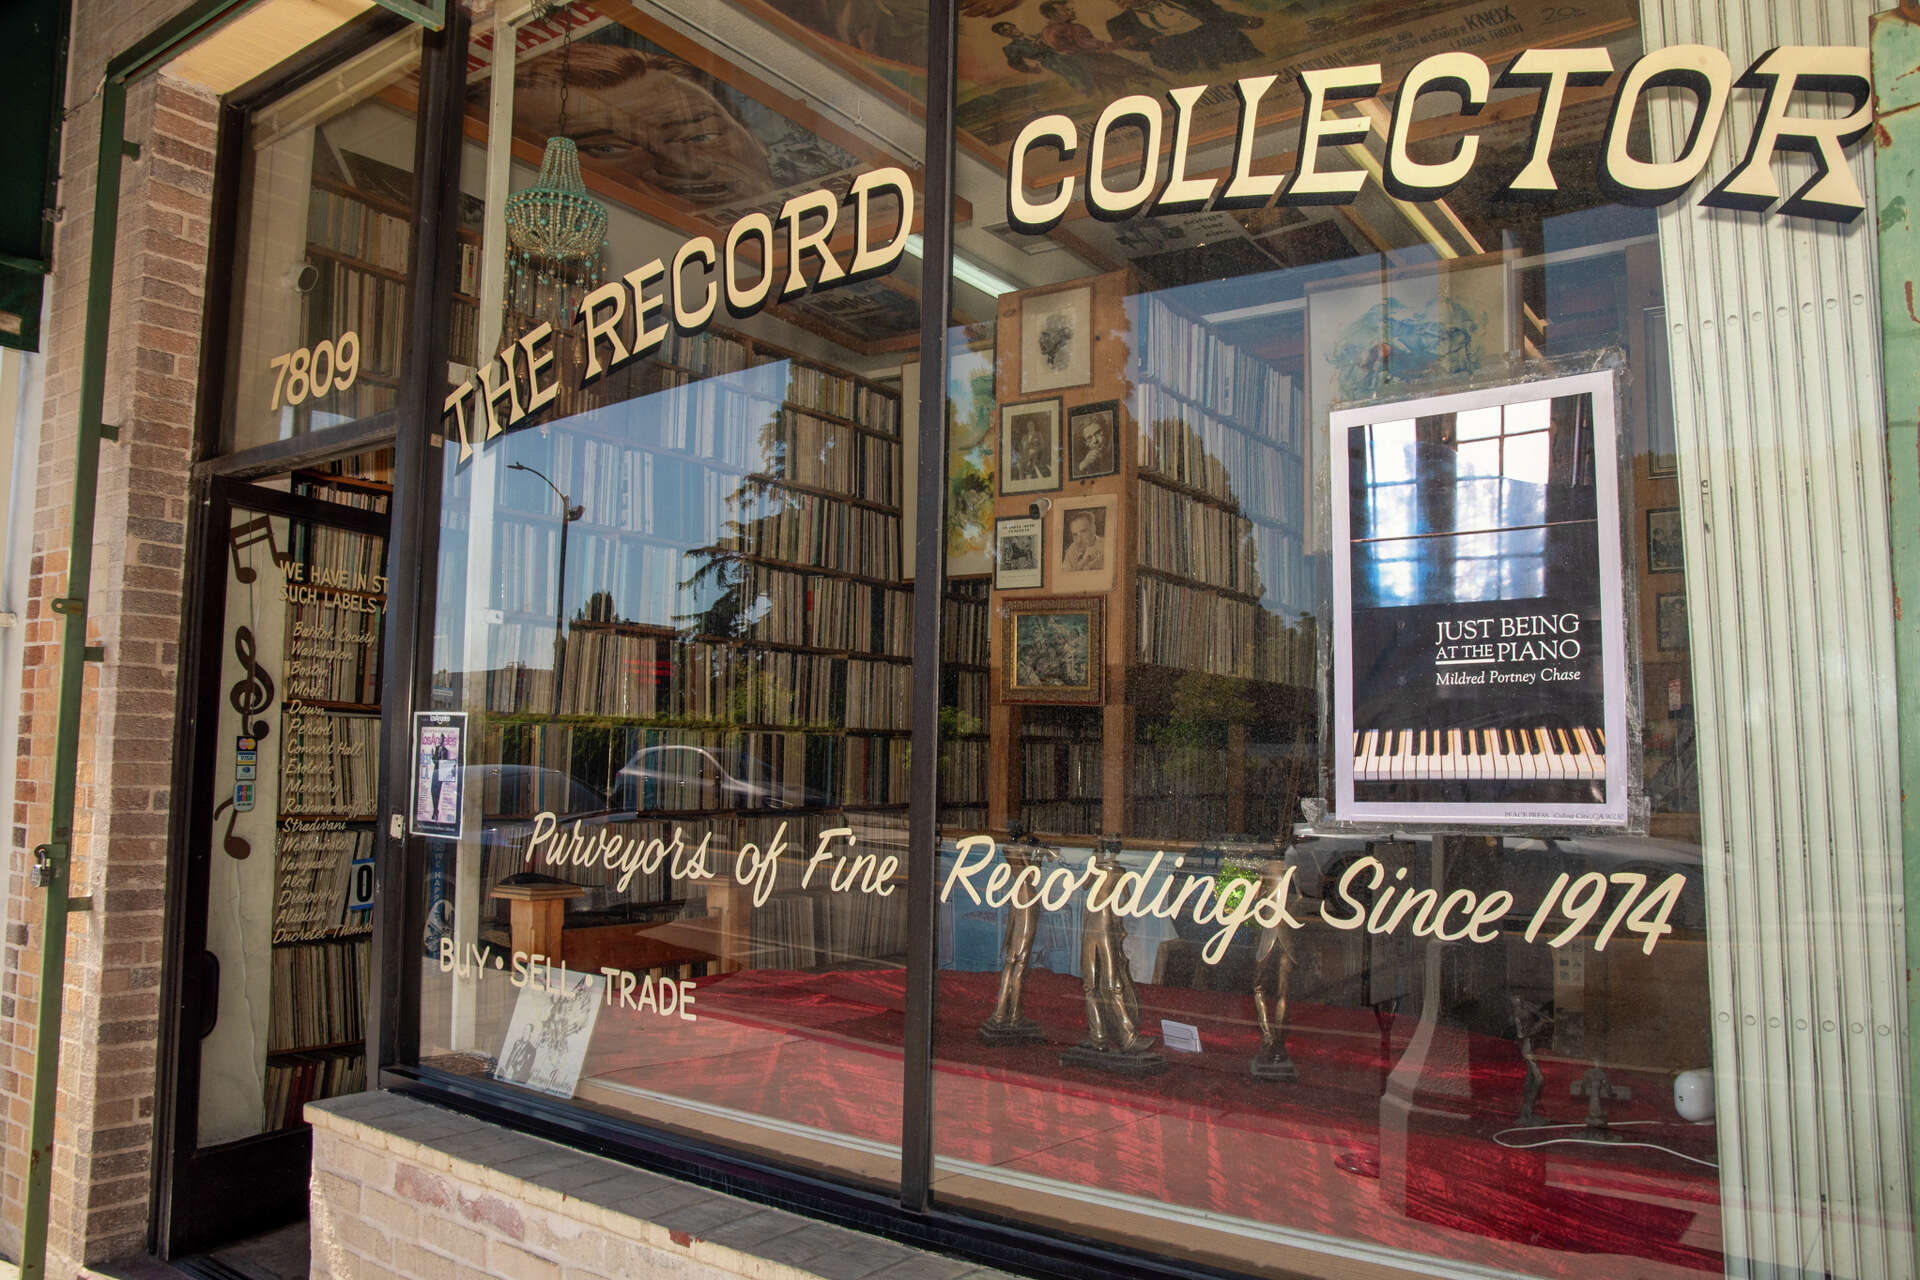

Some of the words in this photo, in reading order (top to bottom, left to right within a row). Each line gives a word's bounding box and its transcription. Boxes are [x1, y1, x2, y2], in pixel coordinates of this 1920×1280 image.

[441, 321, 561, 474] THE
[577, 166, 915, 390] RECORD
[1007, 44, 1876, 236] COLLECTOR
[270, 331, 360, 411] 7809
[280, 560, 304, 581] WE
[311, 565, 348, 588] HAVE
[352, 570, 367, 592] IN
[280, 585, 317, 606] SUCH
[324, 591, 377, 614] LABELS
[1436, 619, 1495, 645] JUST
[1500, 613, 1580, 637] BEING
[291, 641, 353, 663] Washington
[1436, 646, 1458, 659] AT
[1461, 644, 1494, 658] THE
[1497, 639, 1581, 662] PIANO
[291, 661, 328, 680] Boston
[1436, 671, 1485, 686] Mildred
[1490, 668, 1536, 685] Portney
[1541, 667, 1581, 682] Chase
[289, 699, 325, 716] Dawn
[288, 718, 333, 737] Period
[287, 738, 333, 754] Concert
[338, 741, 364, 756] Hall
[285, 779, 340, 799] Mercury
[526, 811, 714, 893] Purveyors
[735, 821, 788, 908] of
[801, 827, 900, 897] Fine
[940, 835, 1305, 965] Recordings
[1320, 856, 1514, 943] Since
[1524, 872, 1687, 956] 1974
[440, 937, 490, 980] BUY
[510, 951, 576, 998] SELL
[601, 966, 697, 1021] TRADE
